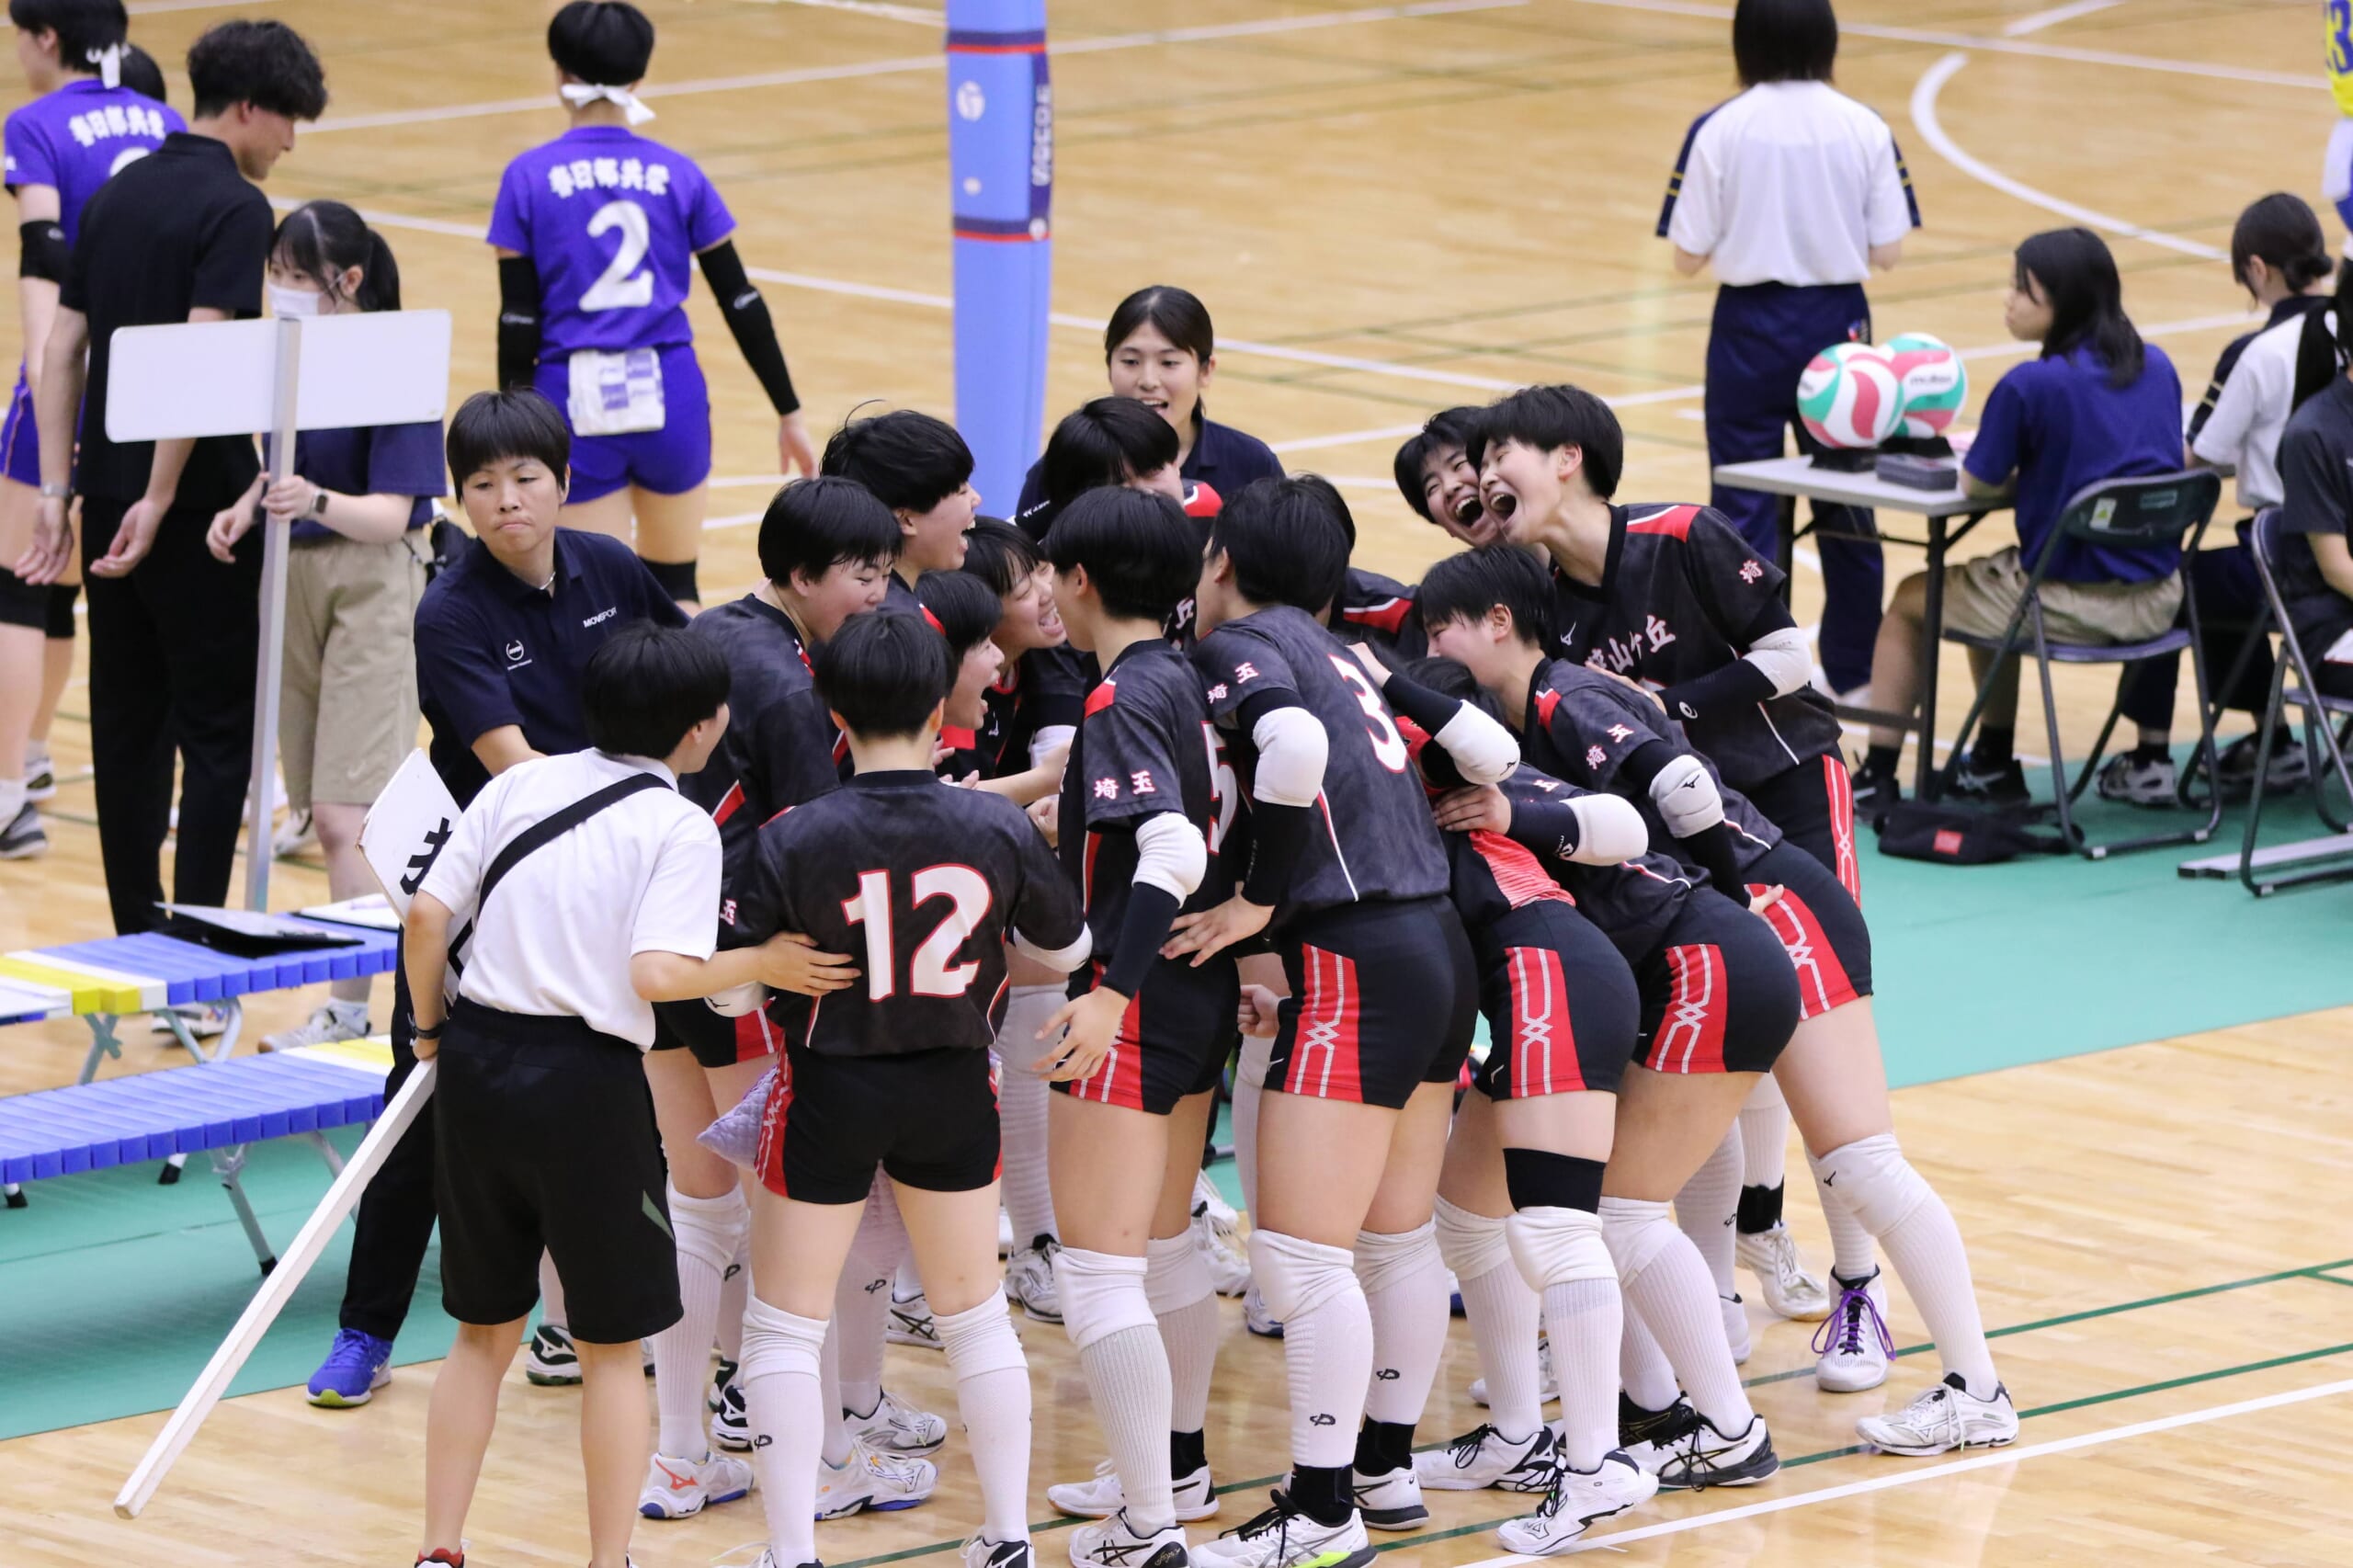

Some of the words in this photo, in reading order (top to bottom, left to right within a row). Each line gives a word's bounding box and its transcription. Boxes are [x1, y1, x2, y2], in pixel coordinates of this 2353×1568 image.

[579, 199, 654, 312] 2
[1327, 653, 1408, 774] 3
[1094, 769, 1156, 800] 埼玉
[1200, 720, 1238, 857] 5
[840, 862, 994, 1004] 12
